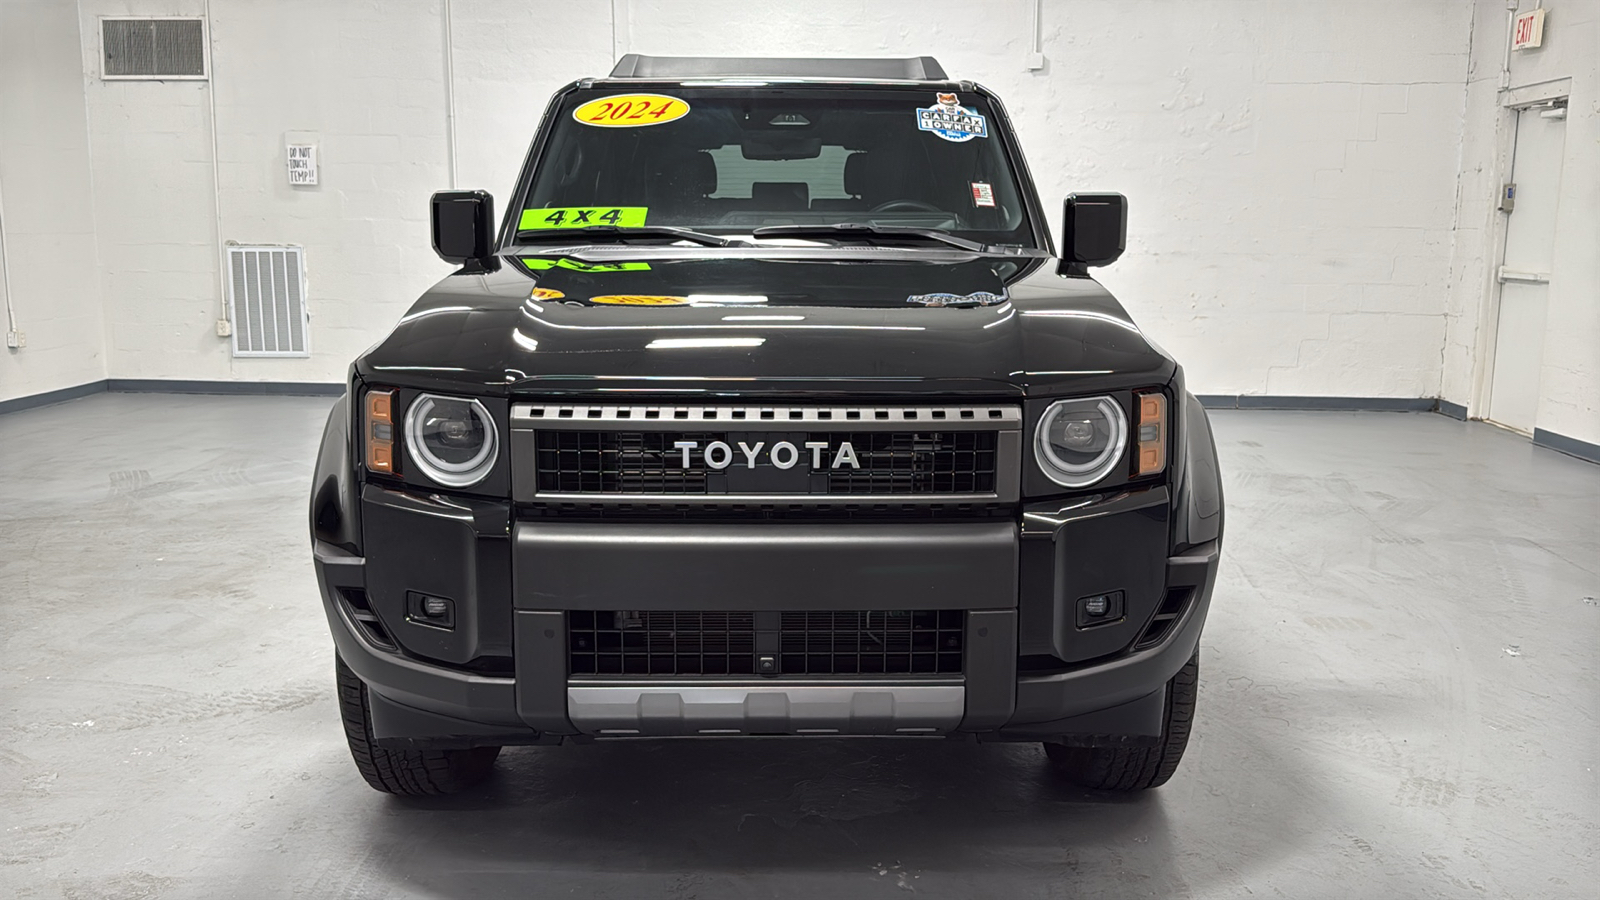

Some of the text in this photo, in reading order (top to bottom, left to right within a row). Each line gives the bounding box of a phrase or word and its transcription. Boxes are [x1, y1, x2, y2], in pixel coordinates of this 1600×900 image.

[1515, 15, 1534, 45] EXIT
[589, 100, 674, 121] 2024
[921, 111, 981, 126] CARFAX
[932, 121, 983, 134] OWNER
[289, 147, 312, 158] DO NOT
[289, 159, 308, 169] TOUCH
[290, 169, 314, 182] TEMP!!
[674, 440, 861, 470] TOYOTA
